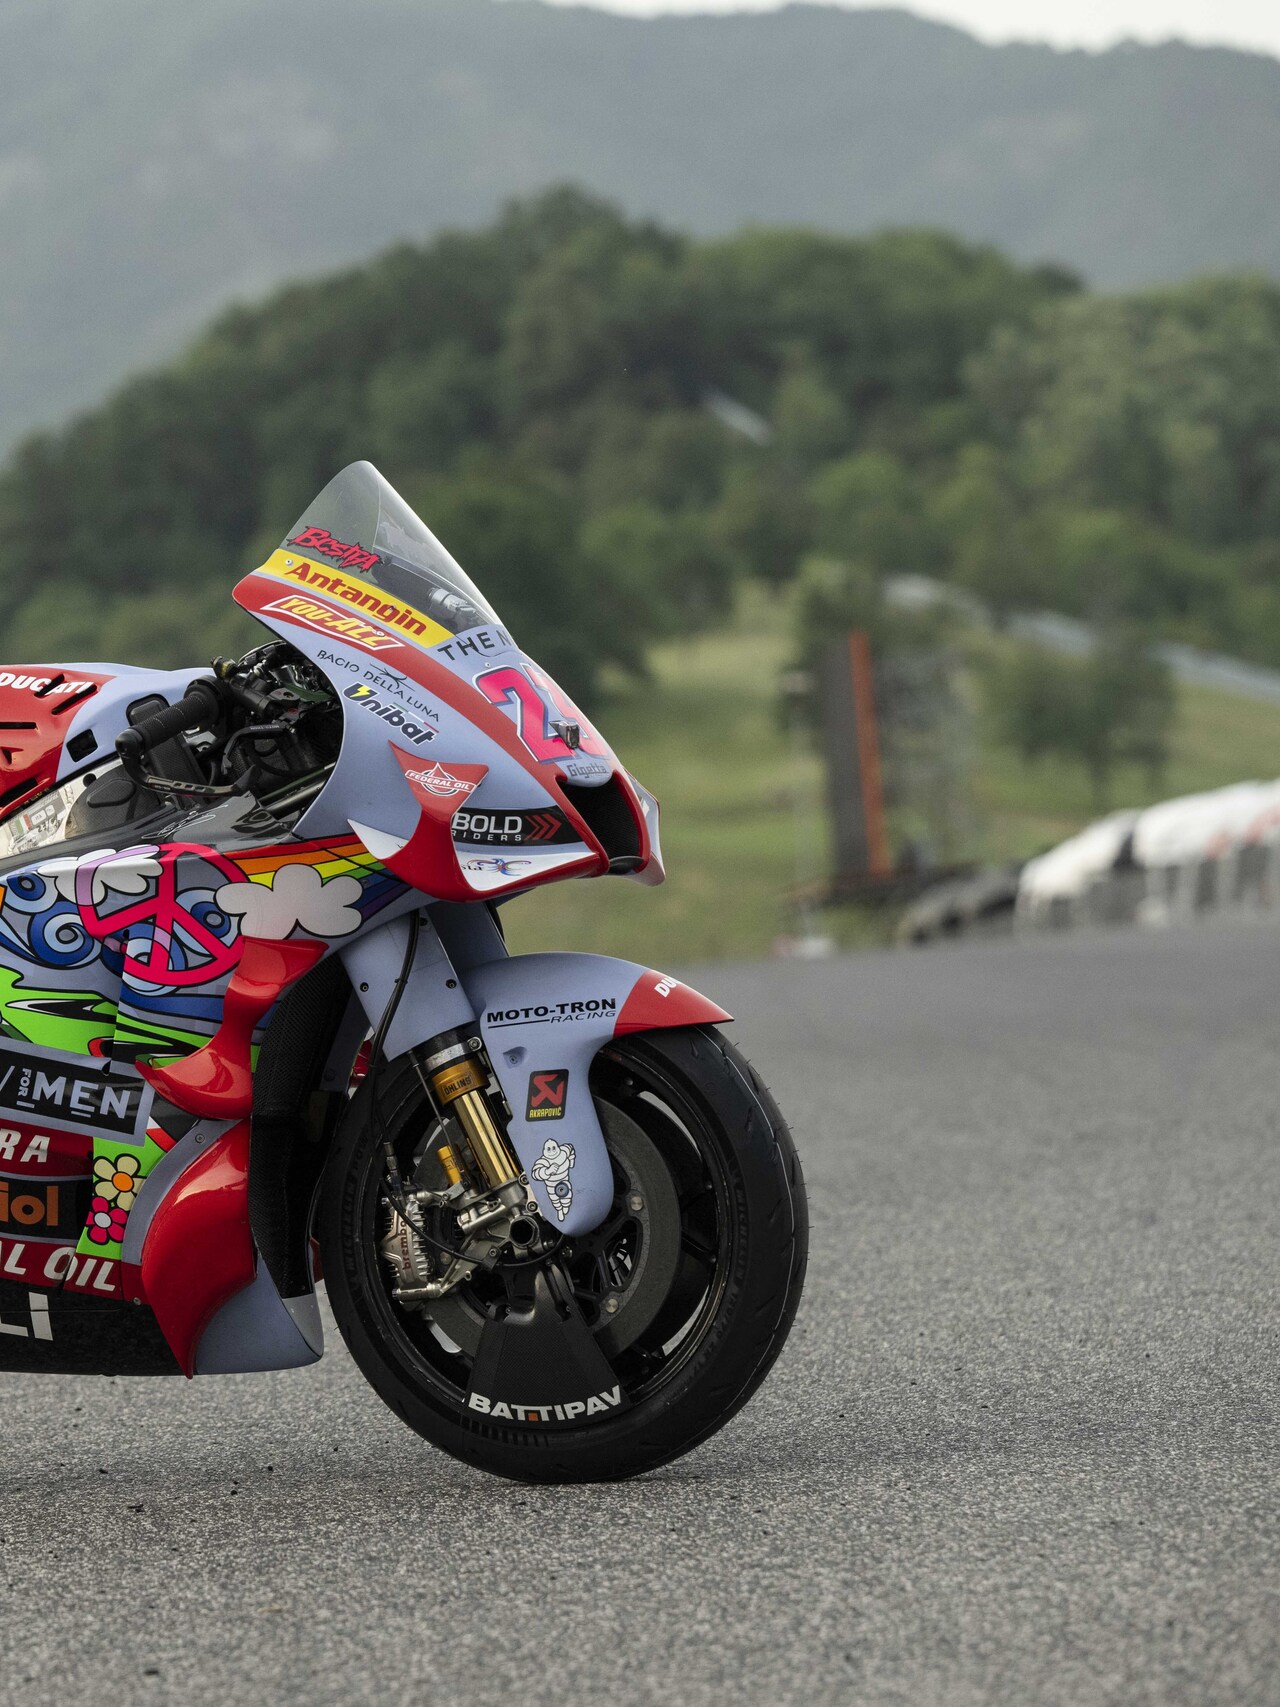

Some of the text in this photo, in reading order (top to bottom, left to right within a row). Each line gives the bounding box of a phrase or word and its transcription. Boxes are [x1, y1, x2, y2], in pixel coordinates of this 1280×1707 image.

[285, 562, 427, 636] Antangin
[437, 632, 495, 661] THE
[317, 650, 439, 722] BACIO DELLA LUNA
[342, 681, 437, 746] Unibat
[409, 772, 470, 790] FEDERAL OIL
[452, 812, 523, 834] BOLD
[487, 998, 616, 1022] MOTO-TRON
[550, 1010, 616, 1024] RACING
[18, 1067, 31, 1097] FOR
[32, 1071, 131, 1119] MEN
[400, 1220, 411, 1271] brembo
[43, 1247, 116, 1292] OIL
[468, 1385, 622, 1421] BATTIPAV
